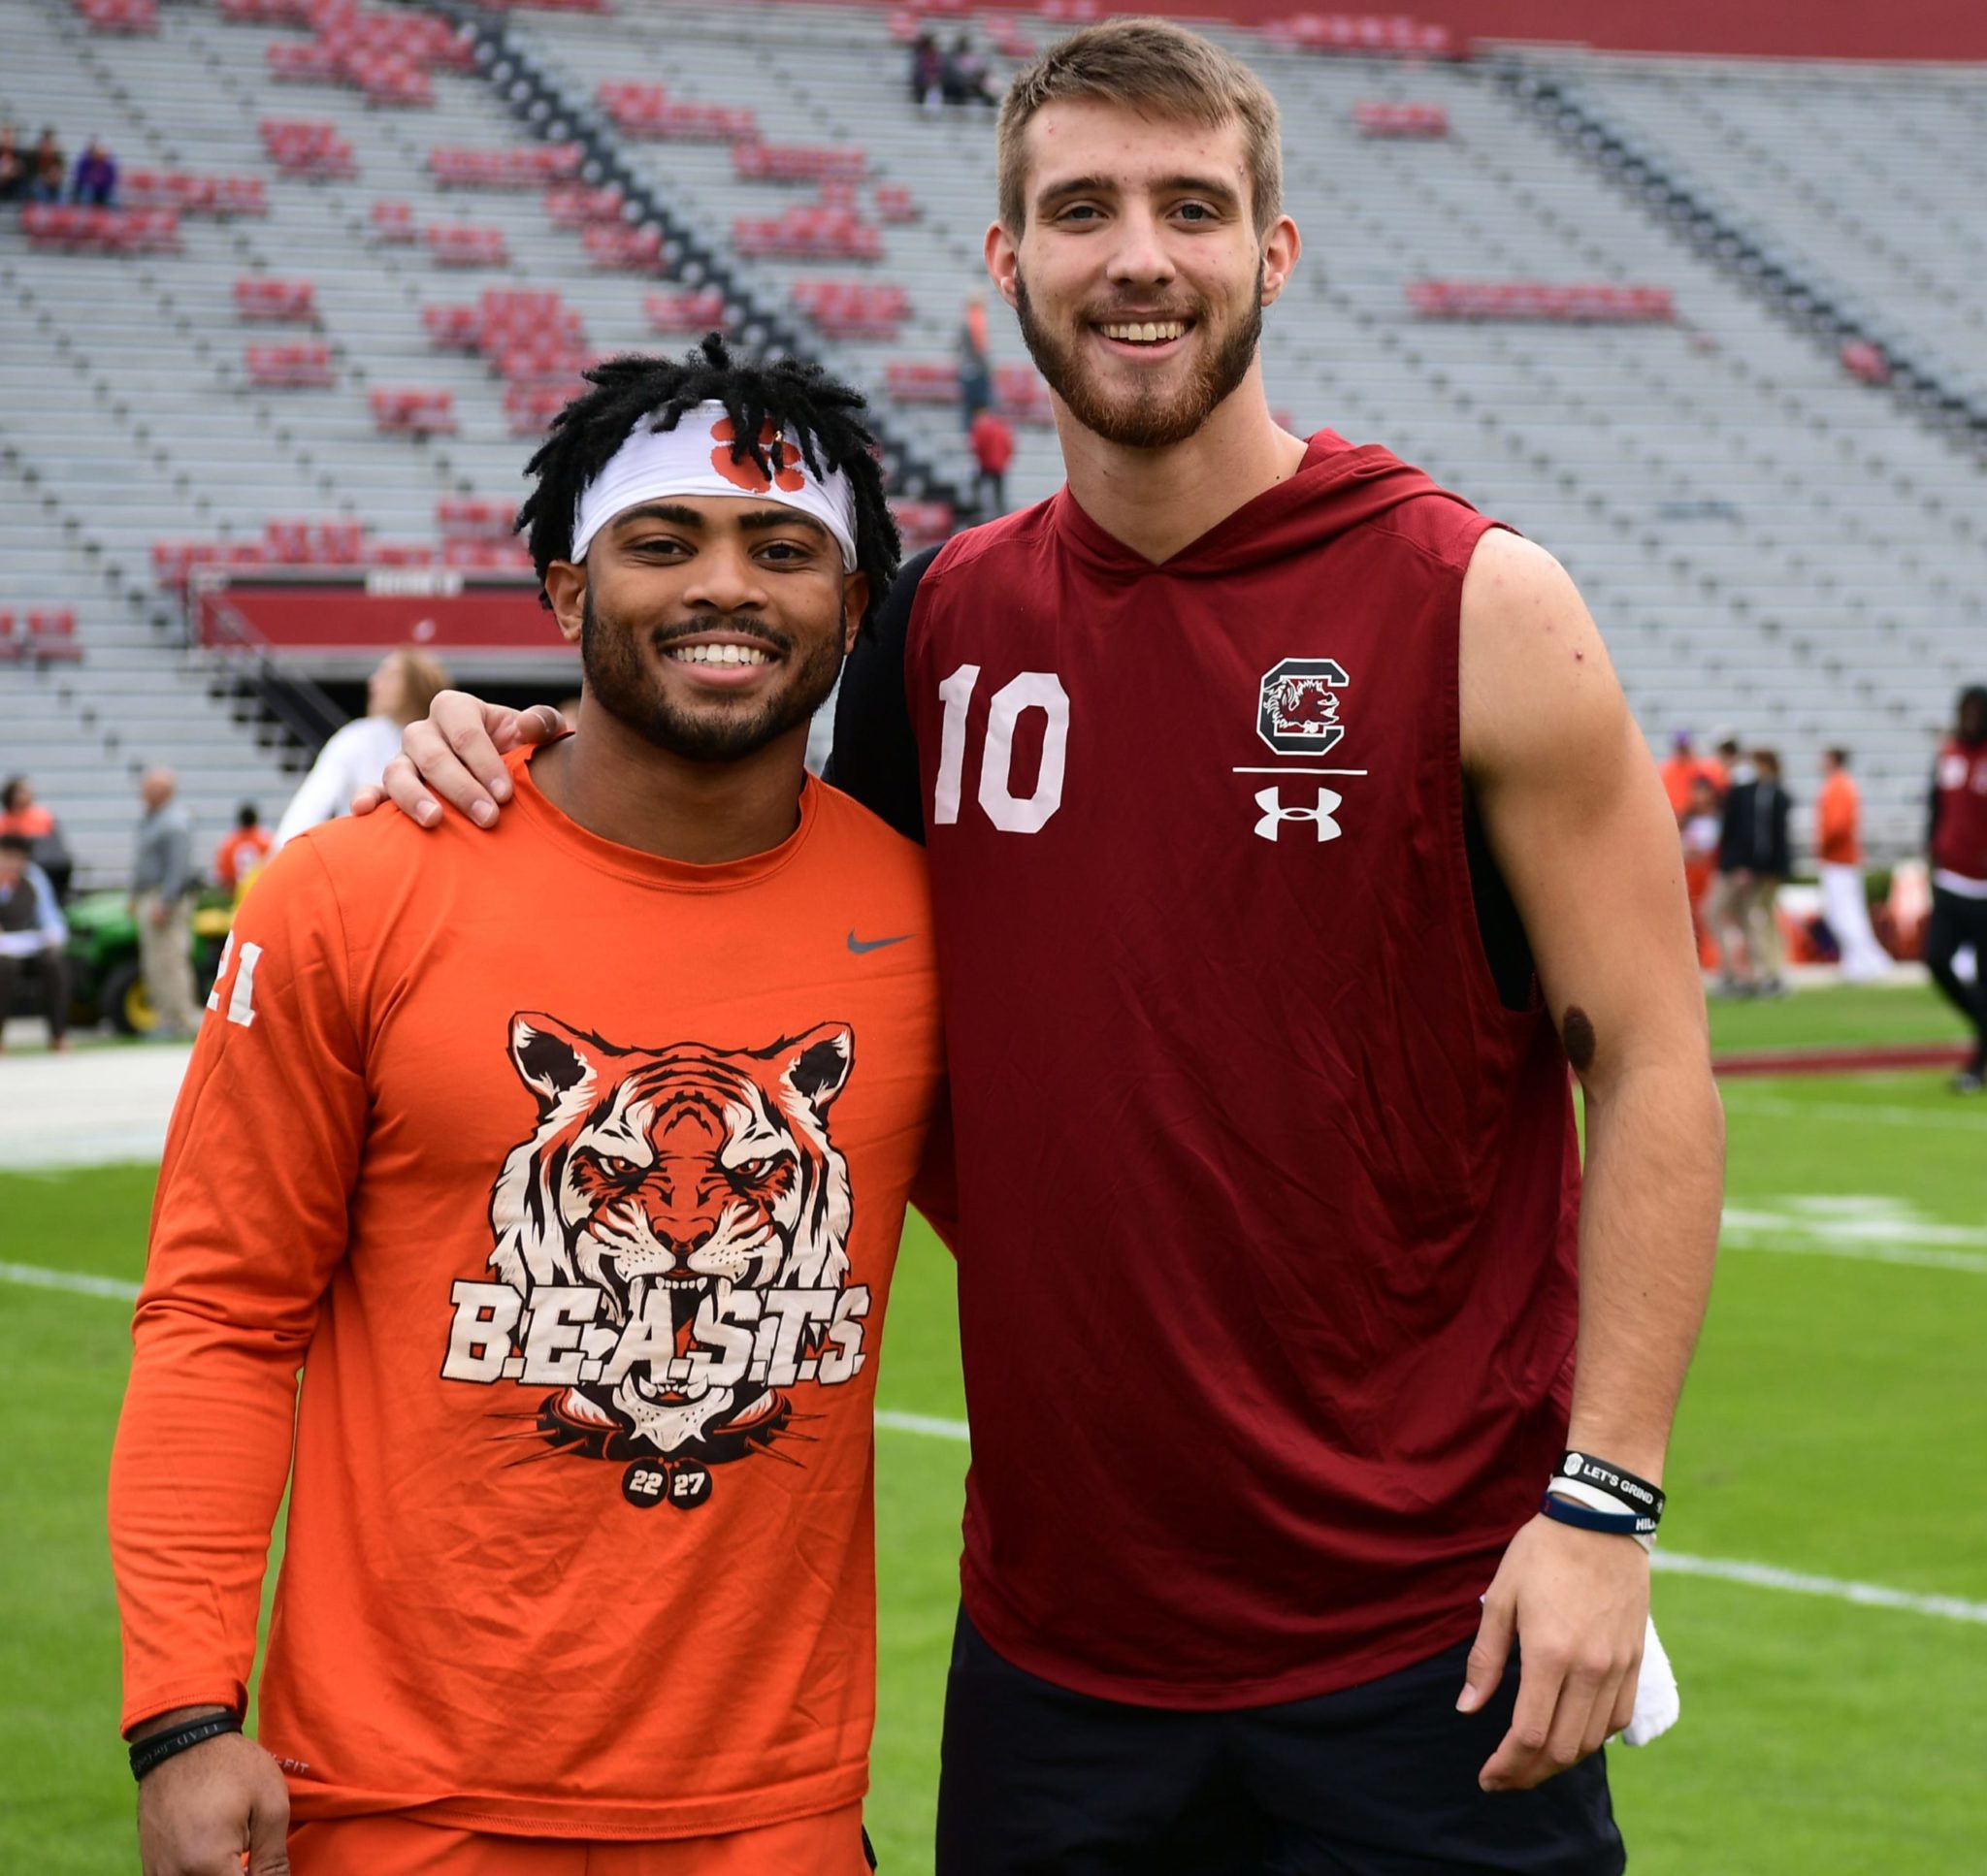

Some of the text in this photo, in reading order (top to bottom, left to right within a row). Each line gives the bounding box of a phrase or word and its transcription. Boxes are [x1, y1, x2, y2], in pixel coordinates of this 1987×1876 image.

[934, 663, 1070, 834] 10
[629, 1470, 664, 1496] 22
[673, 1472, 705, 1497] 27
[1583, 1463, 1654, 1504] LET'S GRIND
